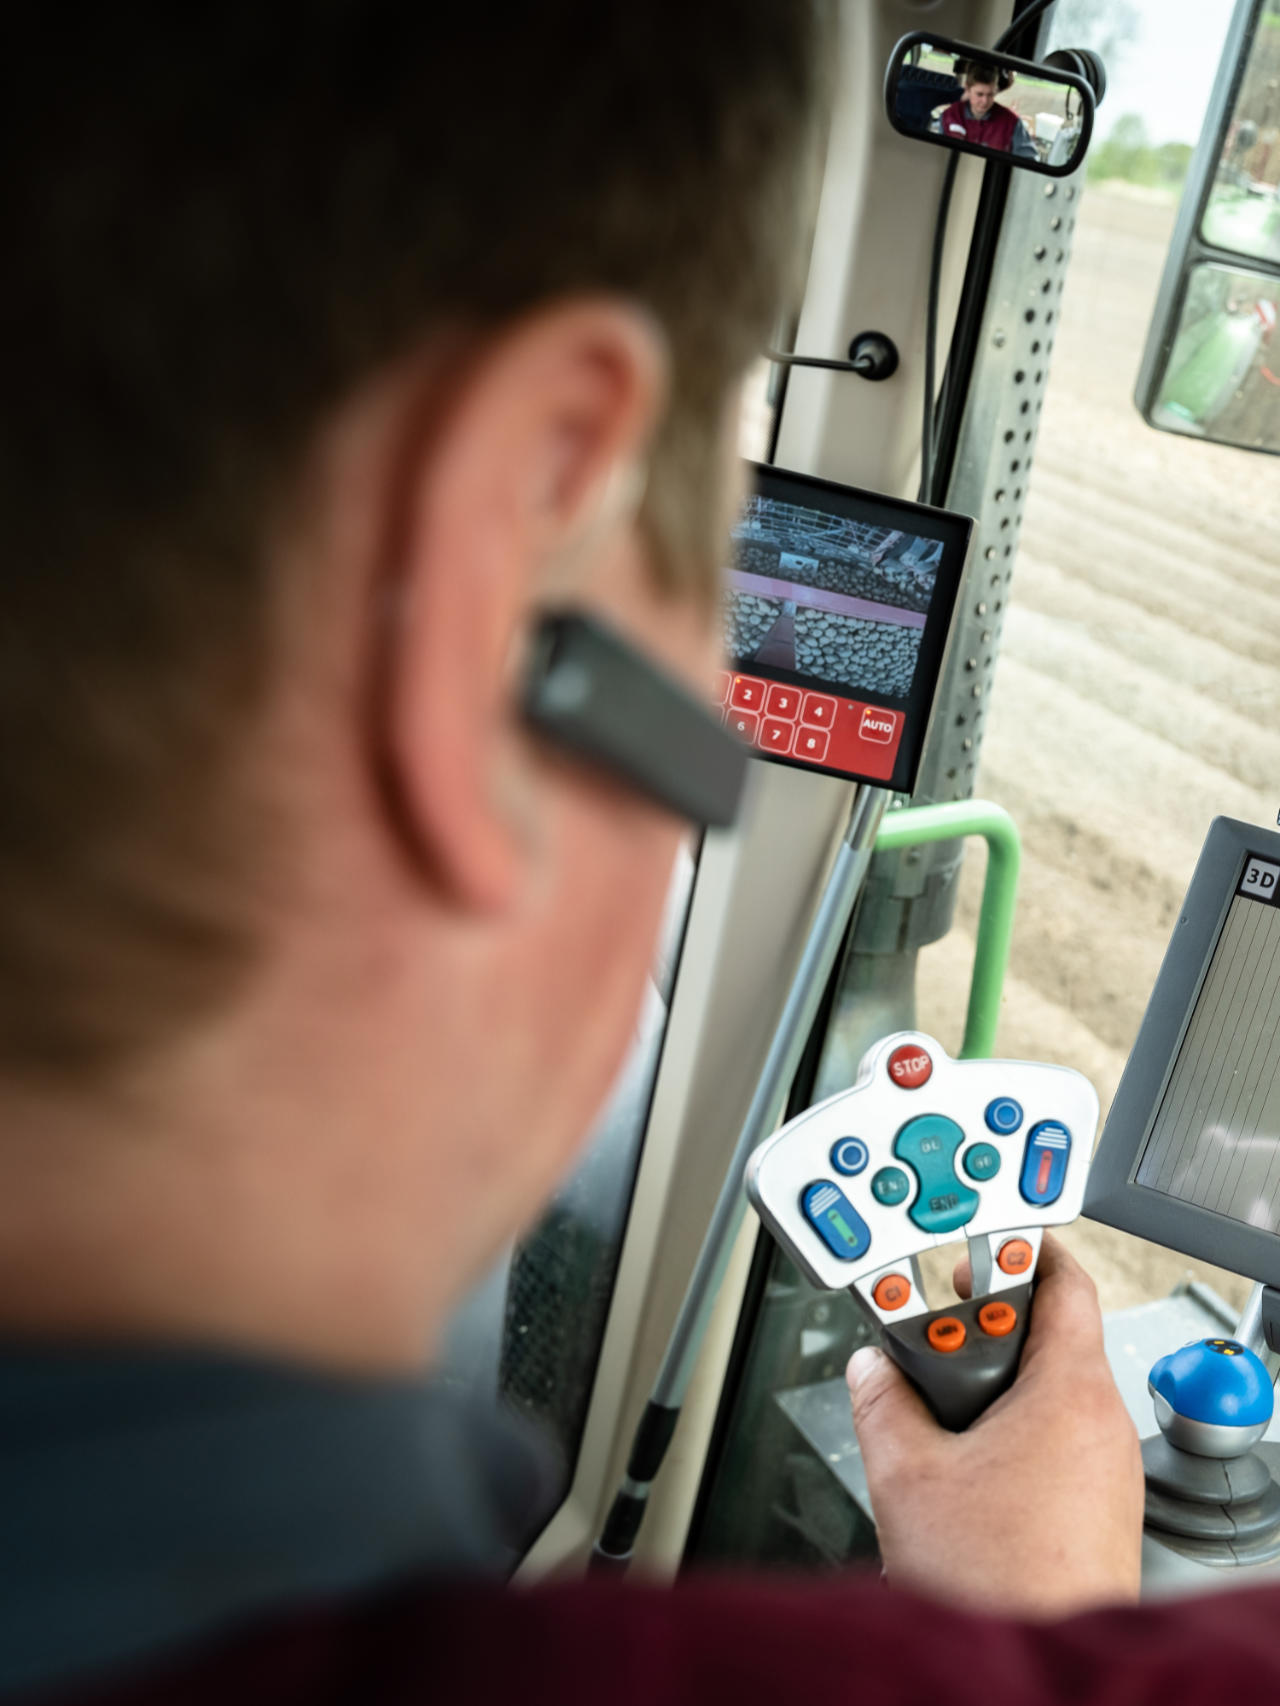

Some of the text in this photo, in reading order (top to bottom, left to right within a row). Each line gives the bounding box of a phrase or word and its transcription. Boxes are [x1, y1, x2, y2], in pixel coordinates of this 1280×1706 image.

[743, 689, 752, 700] 2
[778, 698, 788, 708] 3
[814, 707, 823, 717] 4
[737, 722, 745, 731] 6
[863, 719, 892, 733] AUTO
[772, 730, 781, 740] 7
[806, 738, 816, 749] 8
[1246, 868, 1275, 888] 3D
[893, 1055, 930, 1077] STOP
[1007, 1252, 1026, 1266] C2
